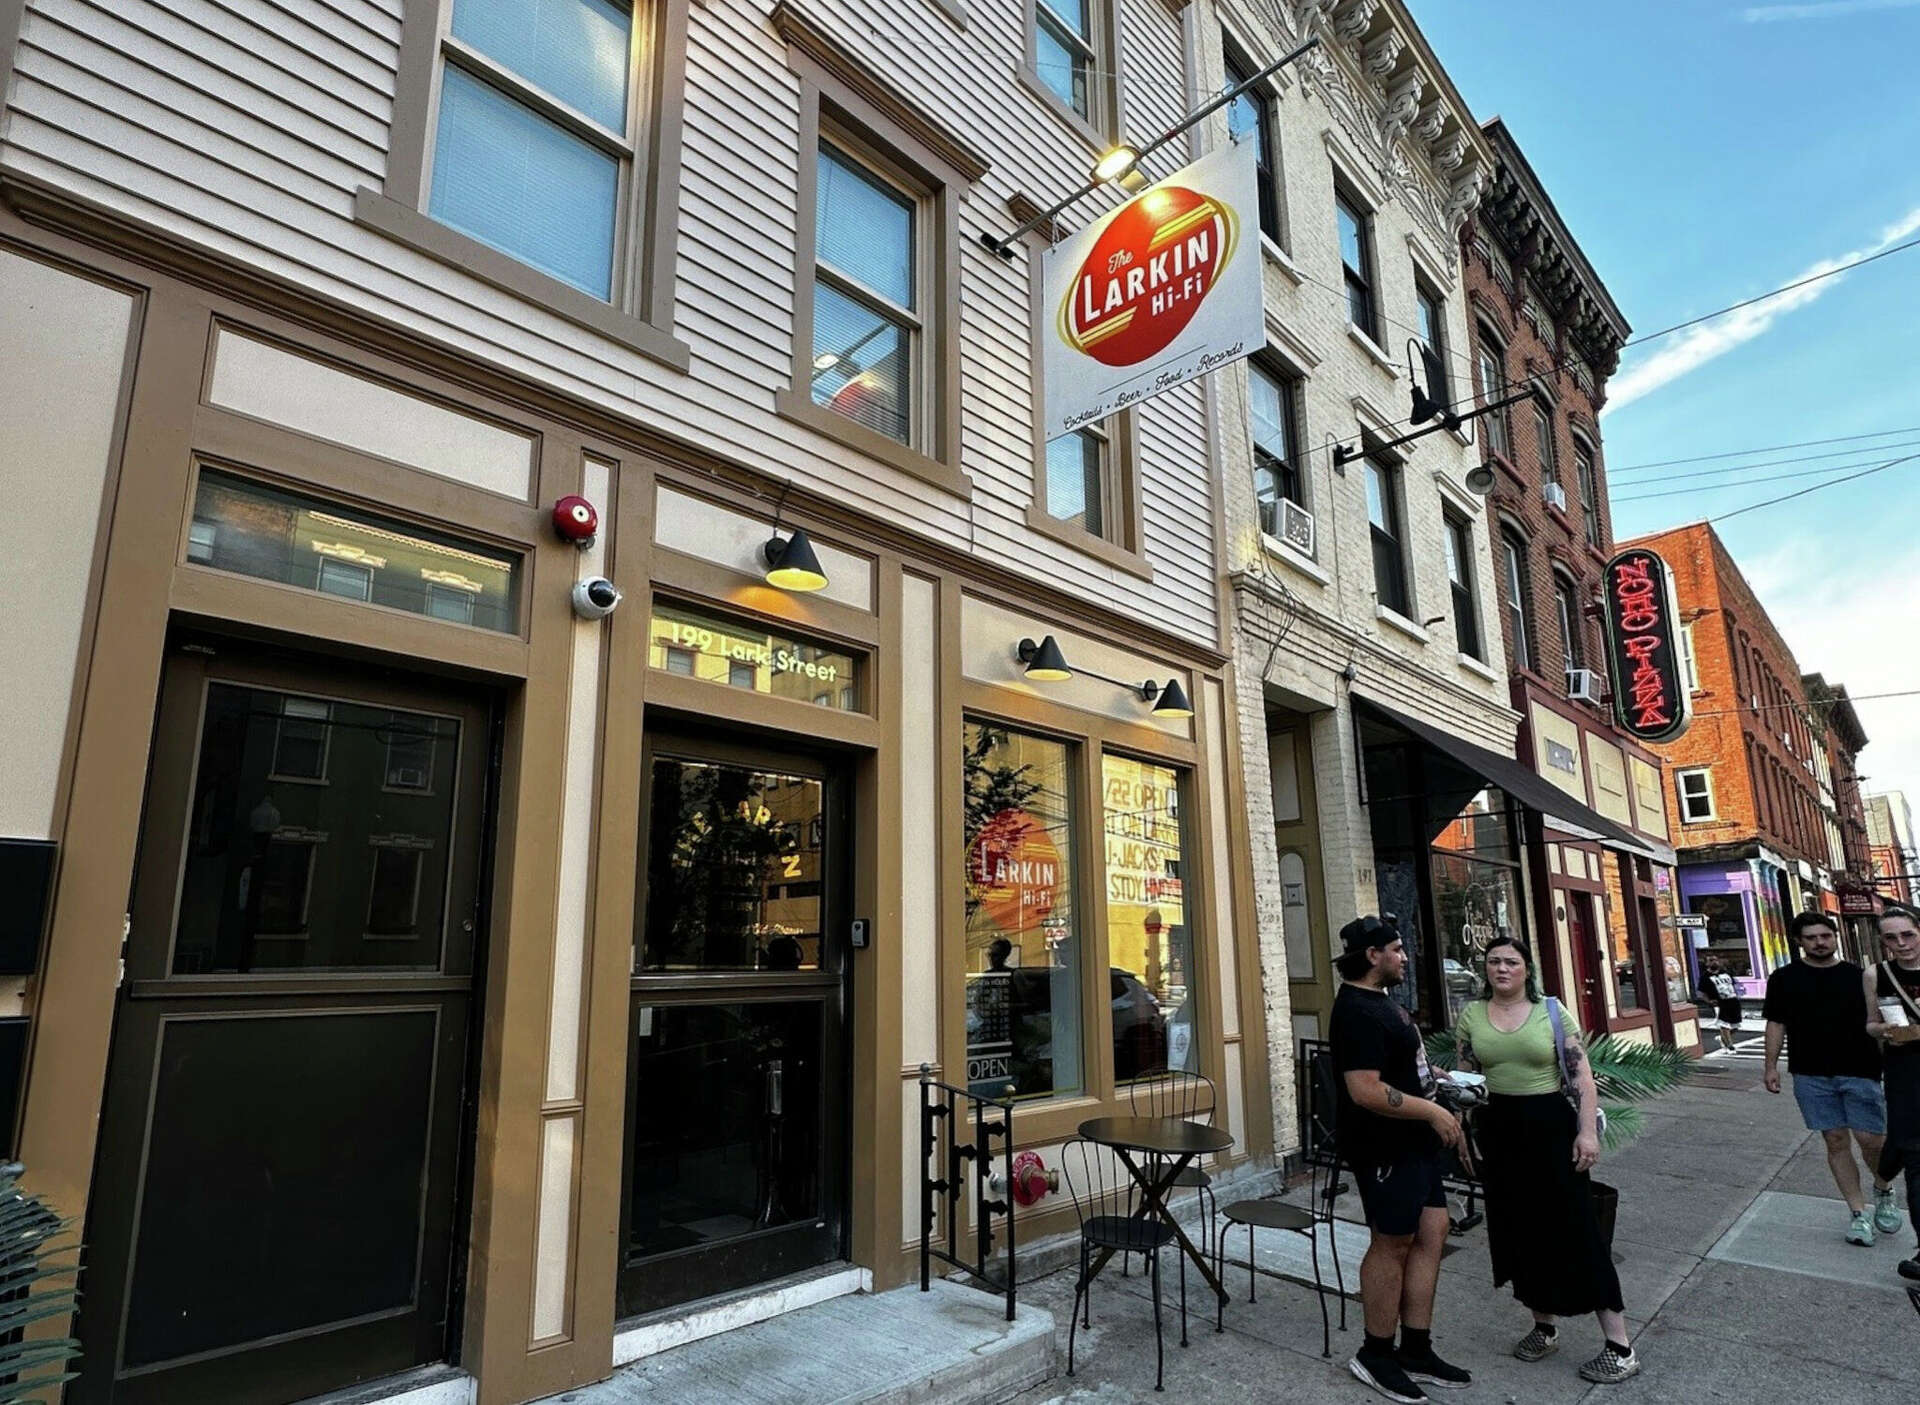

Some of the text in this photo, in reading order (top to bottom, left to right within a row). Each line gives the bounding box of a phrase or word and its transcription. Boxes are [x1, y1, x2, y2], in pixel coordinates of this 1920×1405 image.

[1083, 230, 1210, 323] LARKIN
[1108, 248, 1134, 274] The
[1151, 272, 1204, 318] Hi-Fi
[1114, 389, 1143, 408] Beer
[1155, 367, 1184, 391] Food
[1197, 341, 1244, 371] Records
[670, 622, 713, 651] 199
[776, 649, 837, 682] Street
[1614, 557, 1672, 728] NOHO PIZZA
[981, 841, 1055, 886] LARKIN
[1023, 889, 1051, 907] Hi-Fi
[968, 1056, 1008, 1079] OPEN
